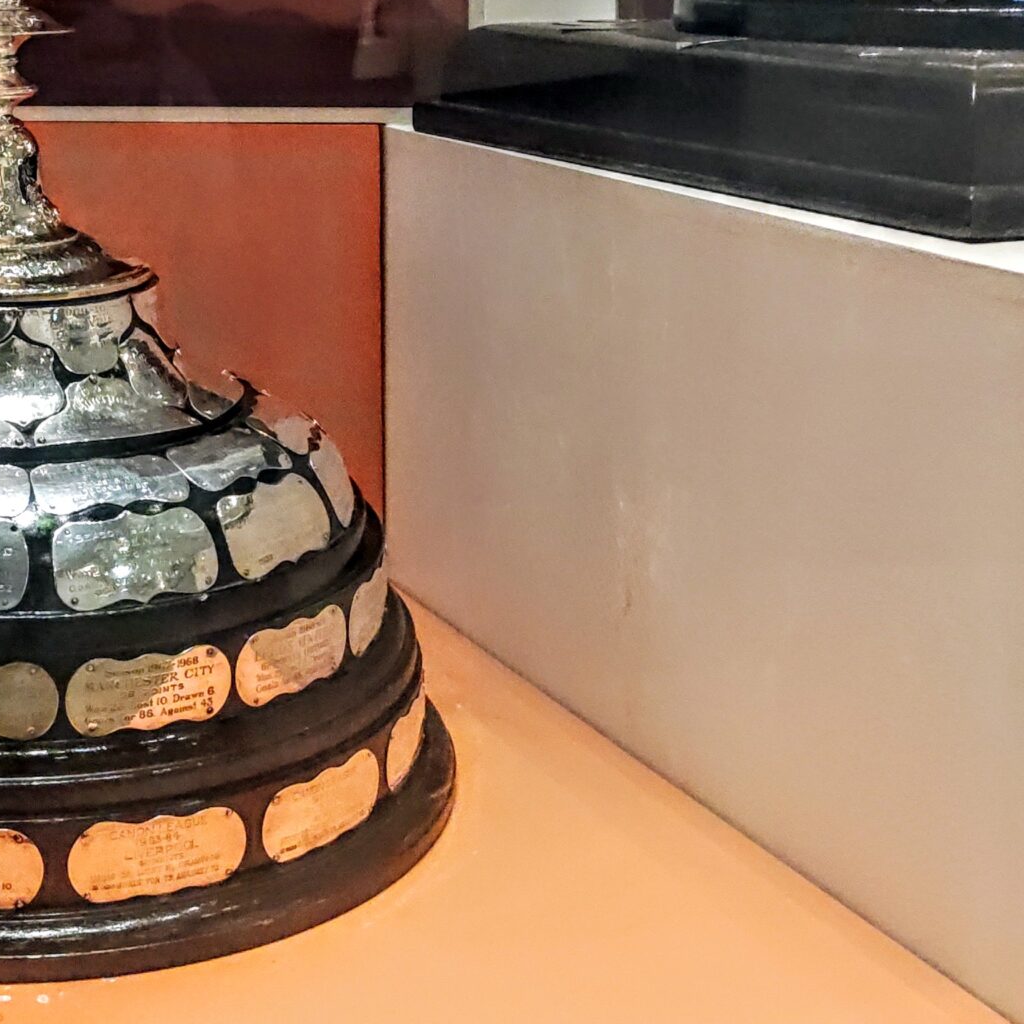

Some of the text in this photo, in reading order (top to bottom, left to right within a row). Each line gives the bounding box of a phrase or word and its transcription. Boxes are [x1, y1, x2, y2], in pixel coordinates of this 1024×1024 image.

[184, 664, 215, 679] CITY
[173, 691, 204, 703] Drawn
[207, 686, 215, 695] 6
[160, 701, 197, 716] Against
